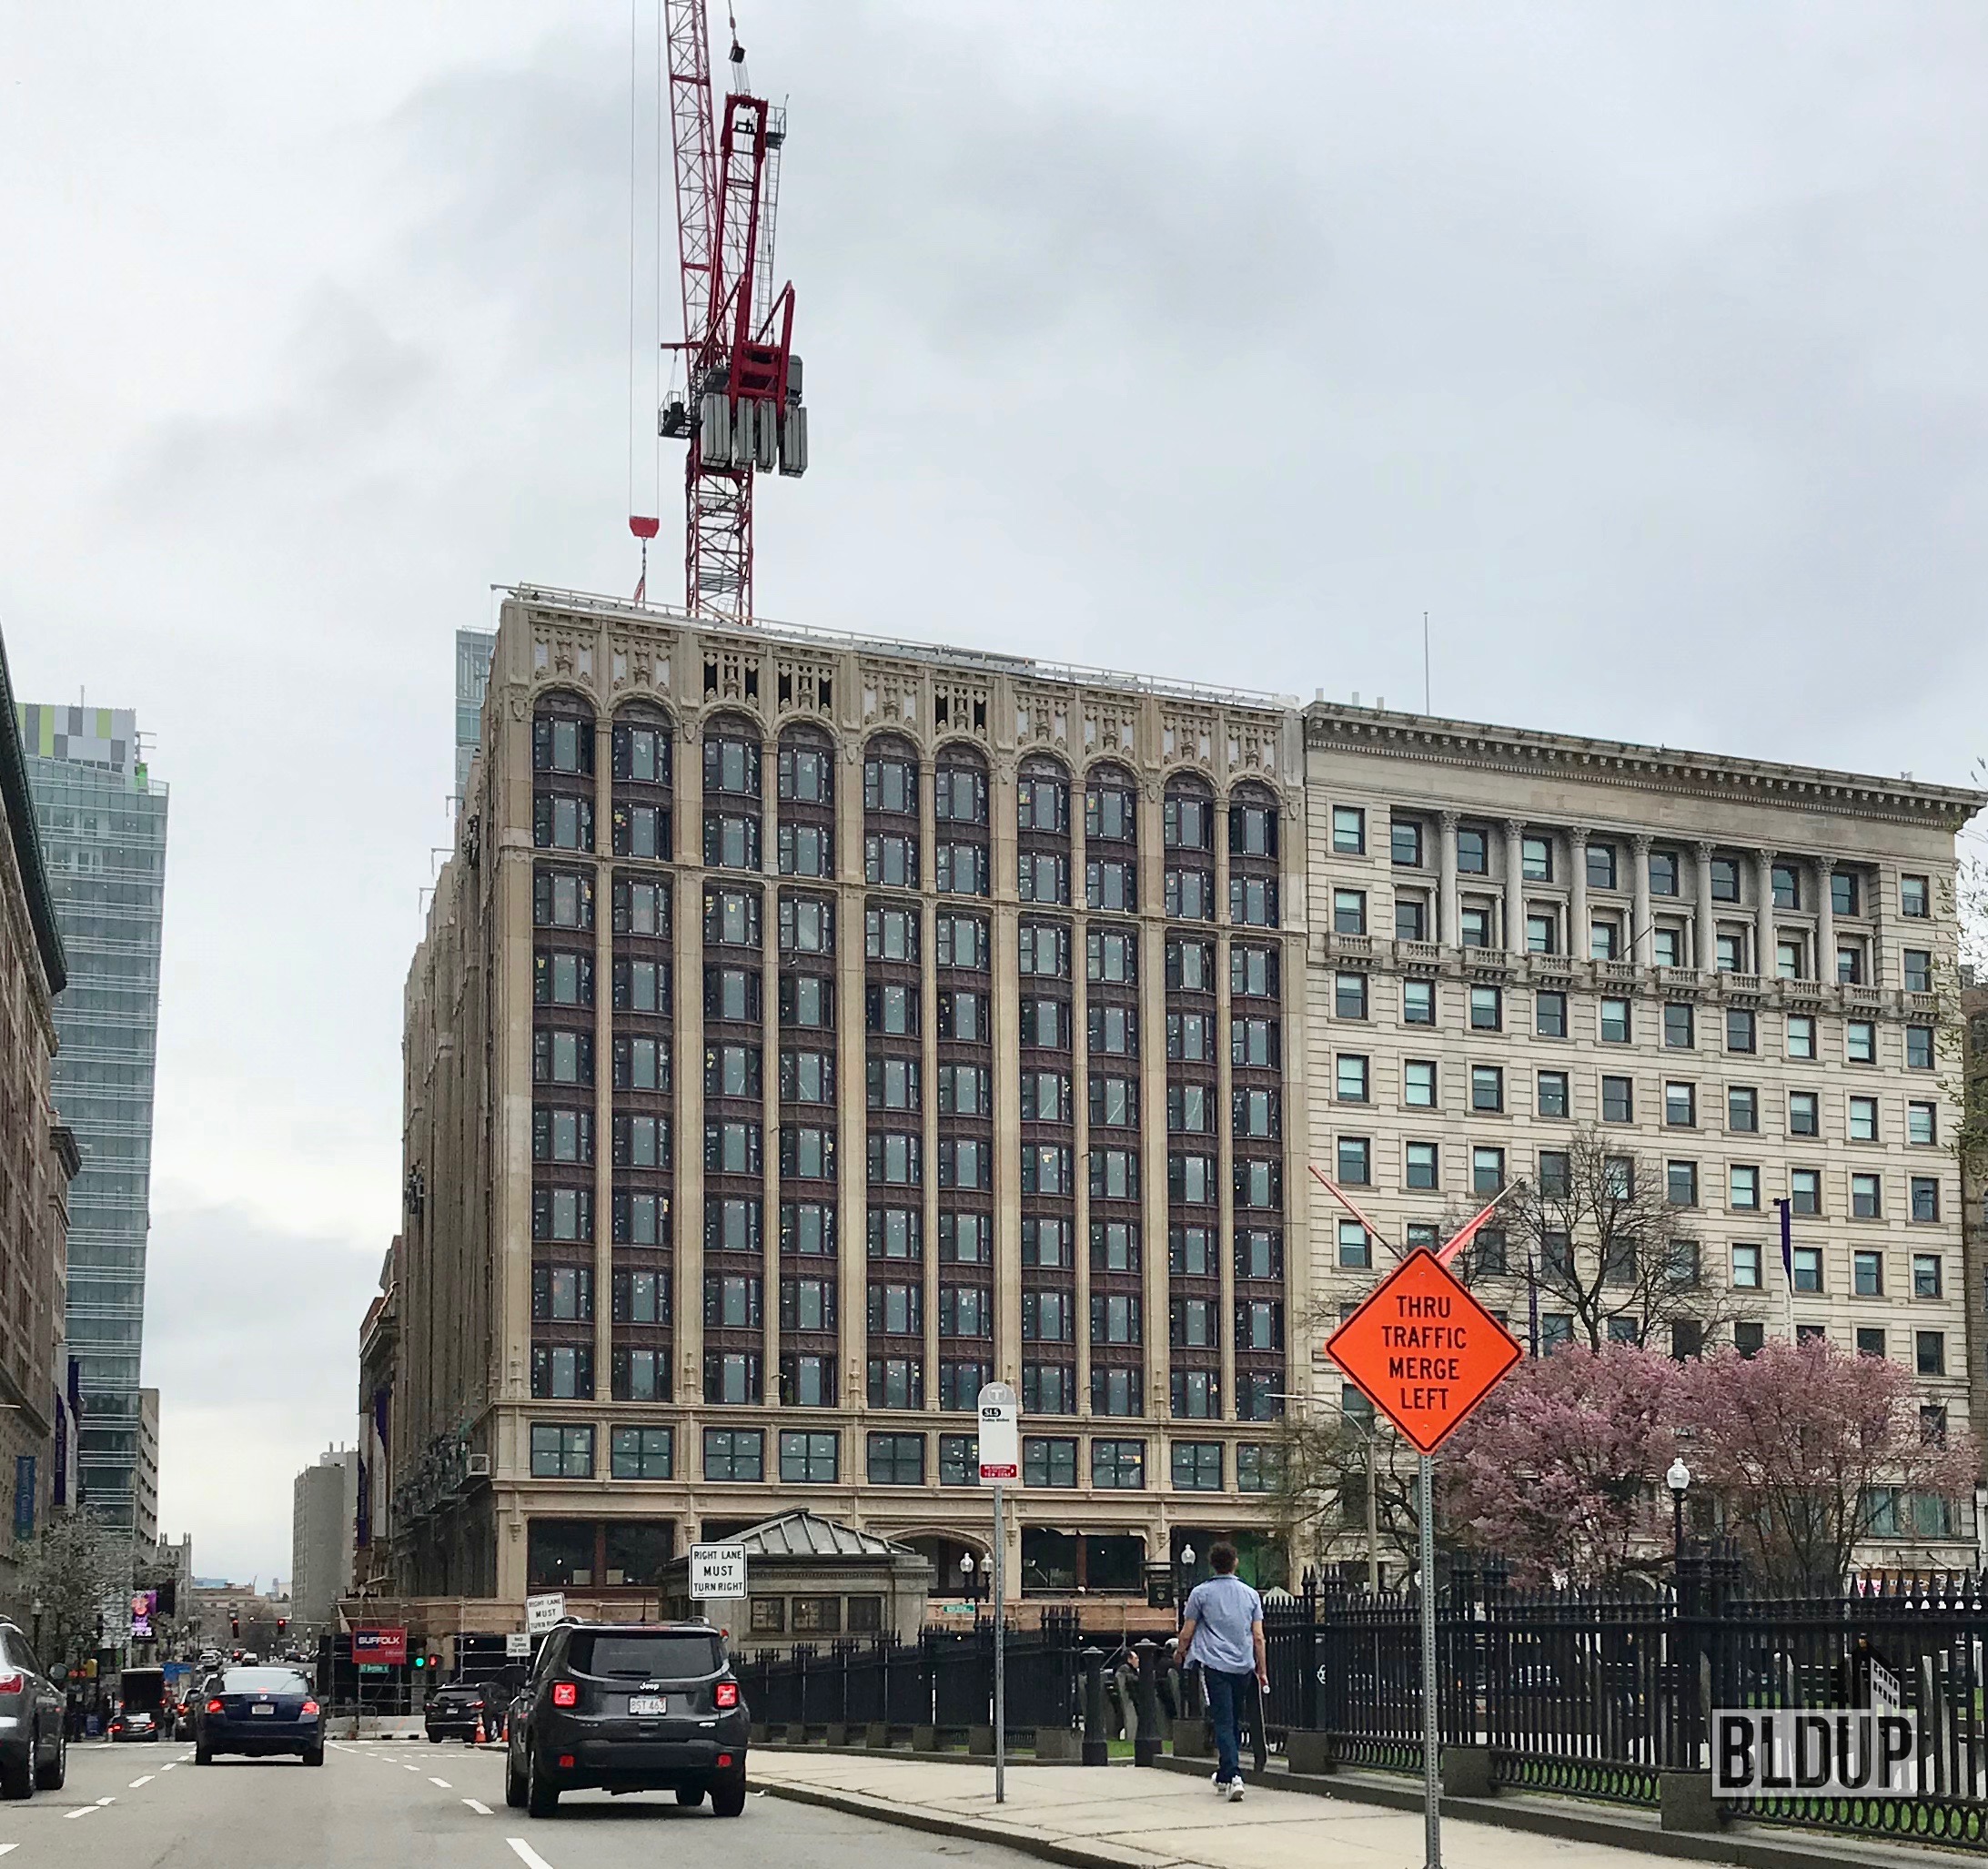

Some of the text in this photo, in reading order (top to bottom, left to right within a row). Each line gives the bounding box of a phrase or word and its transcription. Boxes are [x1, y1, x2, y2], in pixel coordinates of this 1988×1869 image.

[1396, 1295, 1451, 1318] THRU
[1381, 1325, 1467, 1349] TRAFFIC
[1388, 1357, 1460, 1380] MERGE
[991, 1389, 1004, 1400] T
[1400, 1388, 1448, 1409] LEFT
[984, 1409, 1000, 1417] SL5
[693, 1551, 742, 1560] RIGHT LANE
[703, 1565, 733, 1576] MUST
[693, 1581, 743, 1591] TURN RIGHT
[535, 1608, 556, 1618] MUST
[358, 1636, 400, 1645] SUFFOLK
[639, 1682, 660, 1691] Jeep
[649, 1700, 665, 1711] 463
